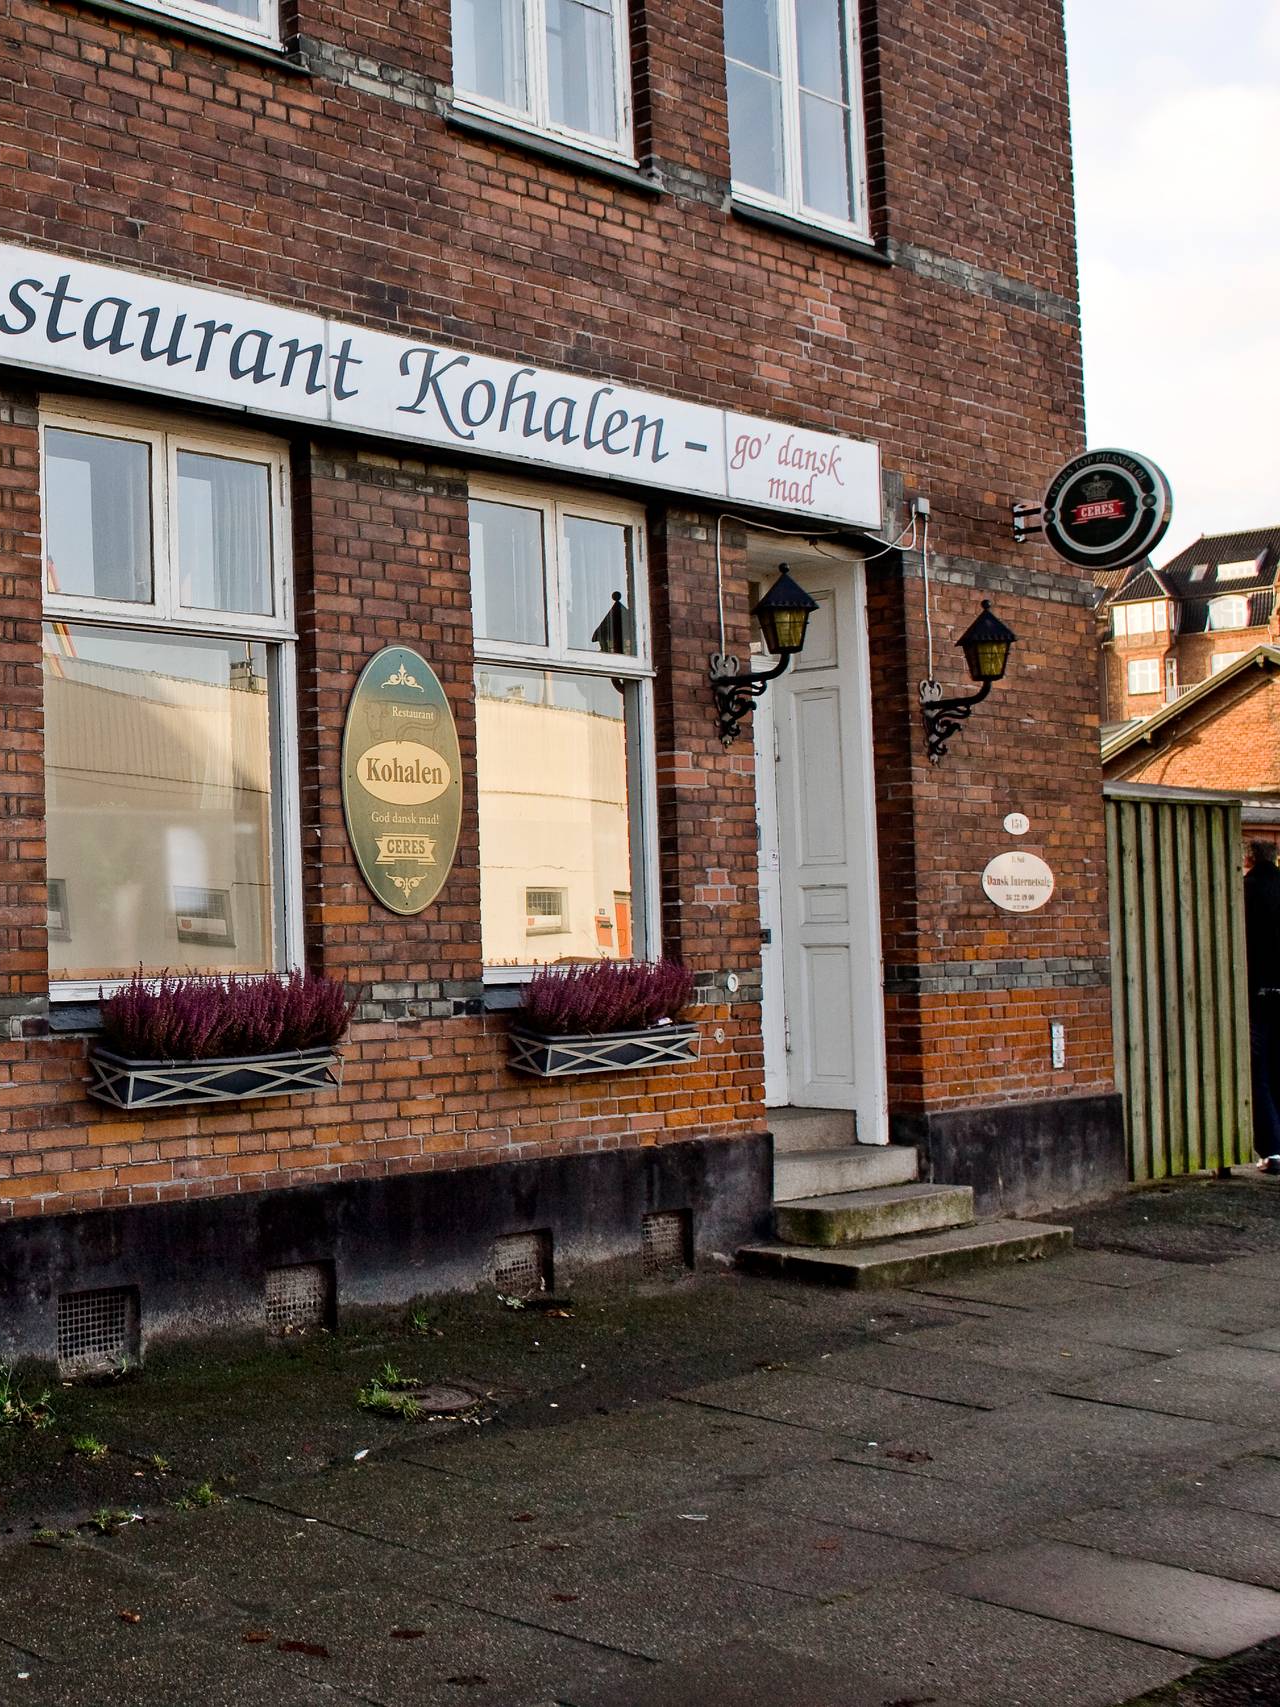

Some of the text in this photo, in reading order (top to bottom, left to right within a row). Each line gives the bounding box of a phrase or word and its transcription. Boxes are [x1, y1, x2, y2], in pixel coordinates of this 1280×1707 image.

[396, 348, 669, 463] Kohalen
[730, 433, 845, 486] go' dansk
[1074, 456, 1094, 470] TOP
[1096, 452, 1135, 470] PILSNER
[768, 473, 818, 505] mad
[1081, 503, 1115, 518] CERES
[392, 706, 434, 721] Restaurant
[366, 757, 443, 785] Kohalen
[371, 811, 439, 825] God dansk mad!
[387, 839, 426, 855] CERES
[987, 875, 1008, 886] Dansk
